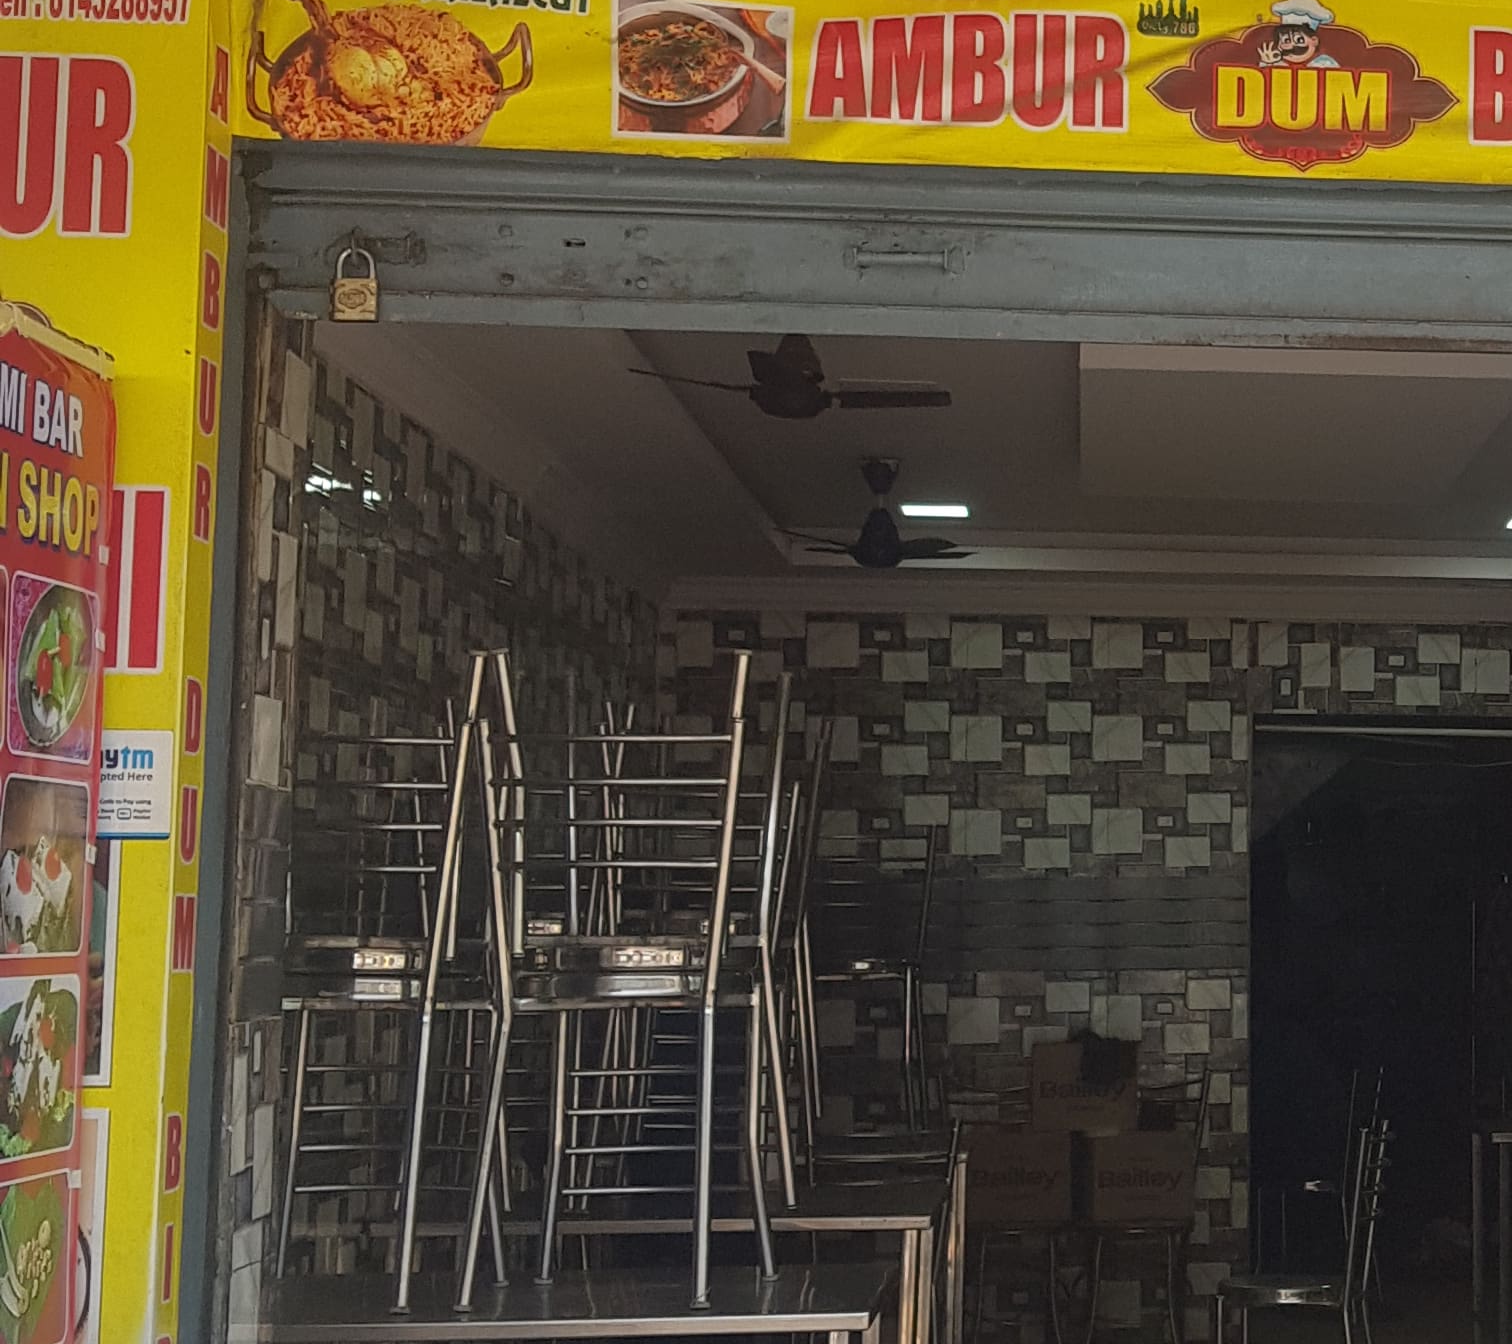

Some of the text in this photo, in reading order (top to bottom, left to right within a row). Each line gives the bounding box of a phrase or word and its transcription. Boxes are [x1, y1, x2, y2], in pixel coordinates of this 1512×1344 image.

[1172, 22, 1196, 35] 786
[807, 9, 1129, 132] AMBUR
[1216, 65, 1390, 133] DUM
[33, 379, 84, 458] BAR
[17, 459, 100, 556] SHOP
[100, 745, 154, 770] ytm
[100, 772, 153, 784] pted Here
